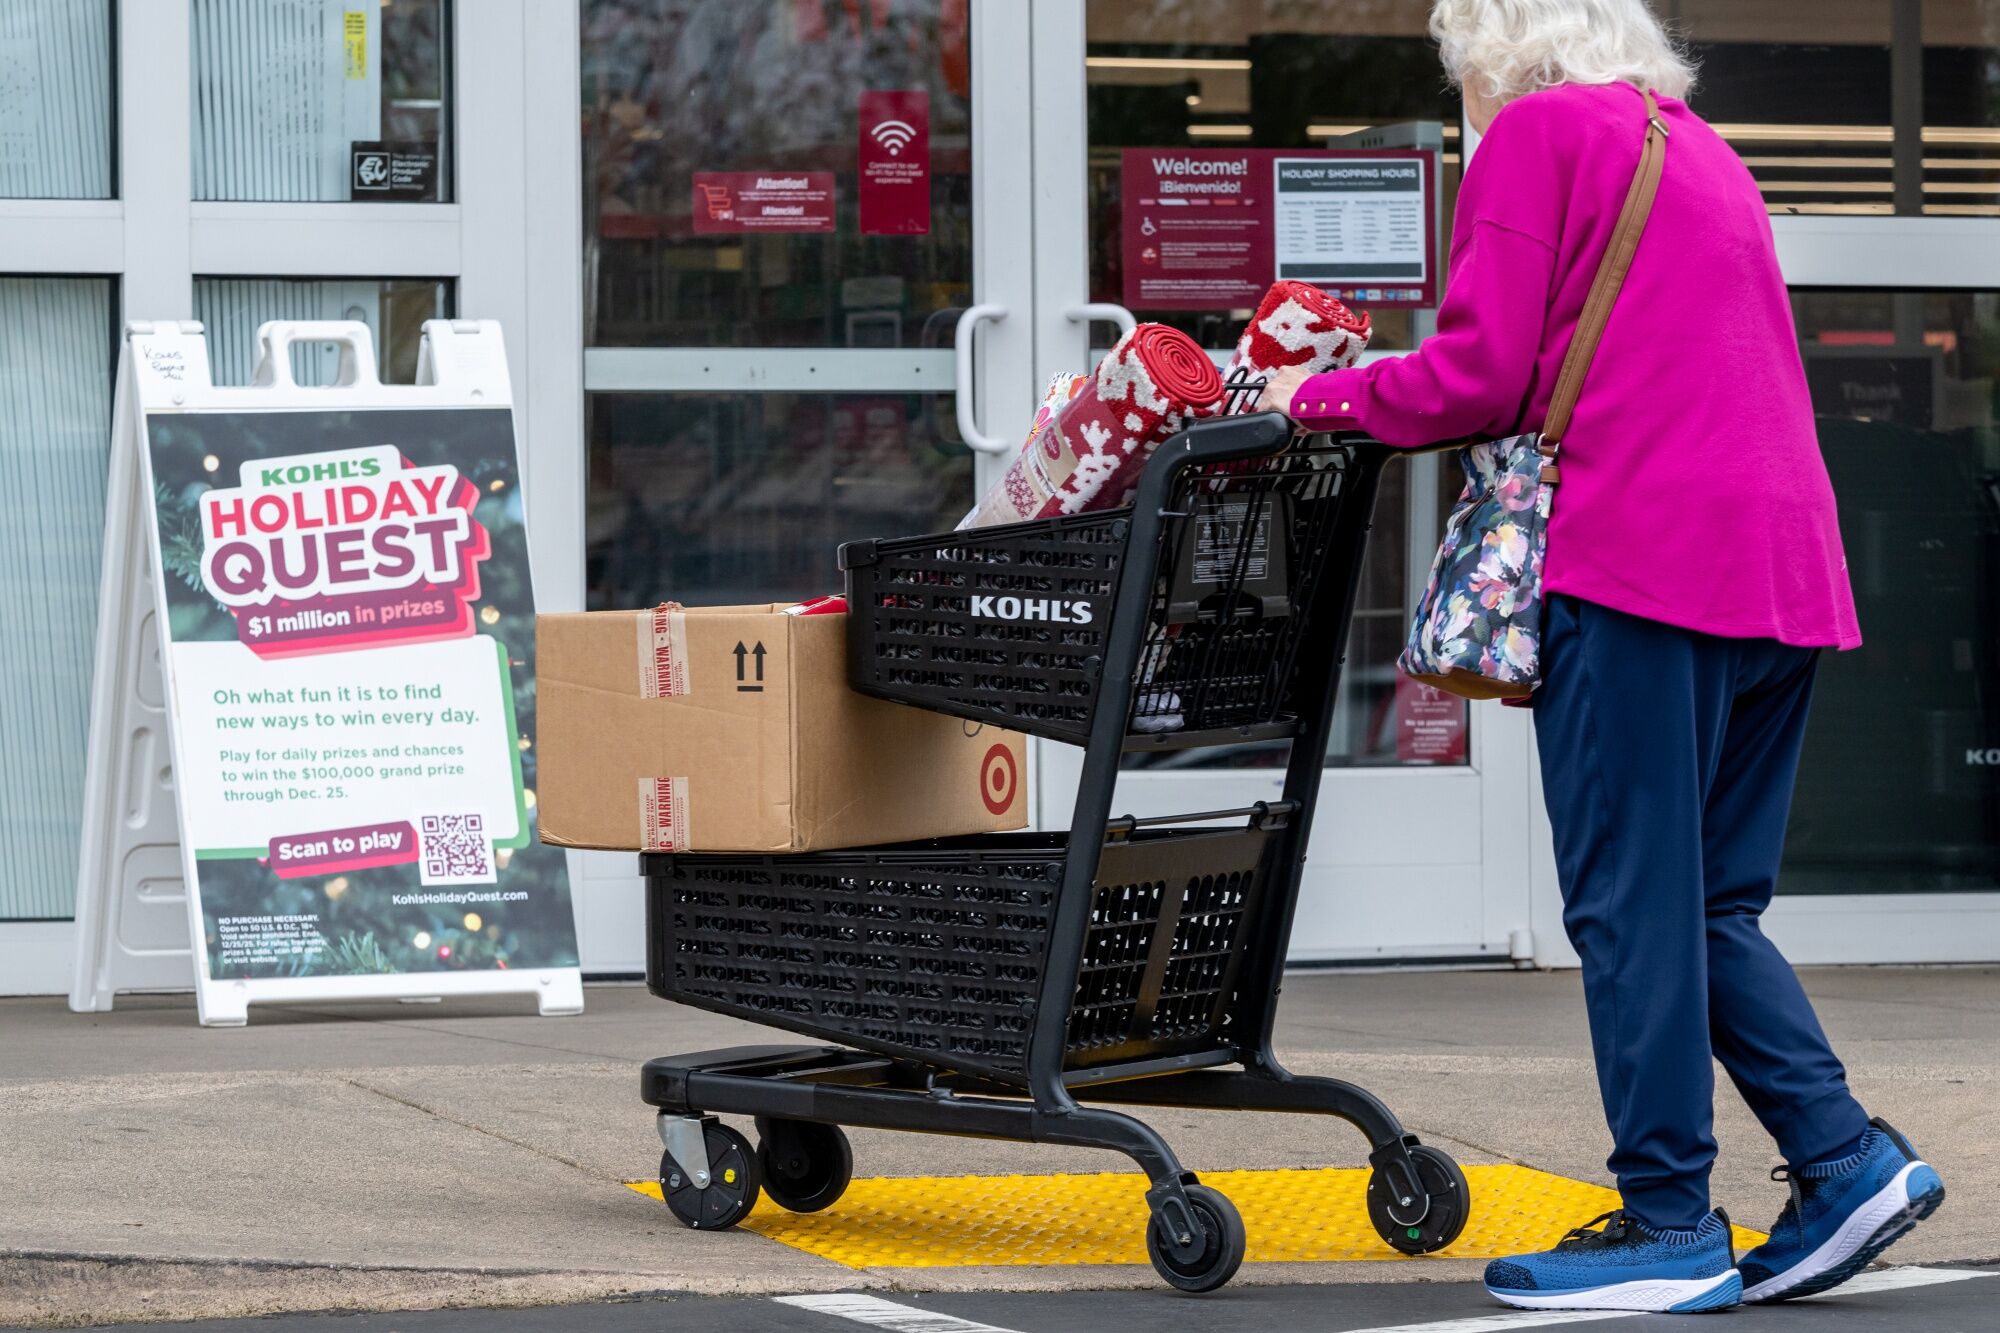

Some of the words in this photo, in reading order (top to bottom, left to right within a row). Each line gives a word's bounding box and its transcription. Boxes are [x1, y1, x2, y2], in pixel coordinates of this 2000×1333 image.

[392, 160, 430, 168] Electronic
[392, 168, 421, 176] Product
[1152, 158, 1248, 175] Welcome!
[1281, 169, 1326, 179] HOLIDAY
[1328, 168, 1379, 179] SHOPPING
[1381, 168, 1417, 178] HOURS
[756, 178, 808, 190] Attention!
[1160, 180, 1241, 193] ¡Bienvenido!
[261, 458, 381, 487] KOHL'S
[210, 475, 446, 539] HOLIDAY
[211, 518, 458, 596] QUEST
[248, 617, 272, 637] $1
[276, 609, 350, 633] million
[355, 605, 376, 623] in
[380, 600, 445, 624] prizes
[971, 595, 1093, 625] KOHL'S
[656, 646, 673, 698] WARNING
[213, 689, 241, 705] Oh
[247, 688, 294, 704] what
[300, 687, 332, 703] fun
[337, 687, 351, 702] it
[357, 686, 372, 701] is
[378, 686, 398, 701] to
[404, 684, 442, 699] find
[216, 715, 255, 729] new
[262, 714, 309, 731] ways
[315, 712, 335, 727] to
[342, 710, 375, 726] win
[381, 711, 434, 727] every
[440, 707, 479, 726] day.
[219, 750, 251, 764] Play
[255, 748, 277, 762] for
[282, 747, 318, 762] daily
[322, 746, 368, 762] prizes
[372, 745, 400, 759] and
[404, 744, 464, 757] chances
[222, 770, 237, 782] to
[242, 769, 268, 781] win
[273, 768, 297, 780] the
[302, 766, 375, 781] $100,000
[380, 765, 423, 780] grand
[427, 764, 465, 778] prize
[224, 788, 283, 802] through
[288, 788, 321, 800] Dec.
[326, 787, 349, 799] 25.
[657, 776, 672, 828] WARNING
[278, 840, 328, 861] Scan
[332, 837, 355, 854] to
[360, 831, 403, 853] play
[392, 891, 529, 905] KohlsHolidayQuest.com
[219, 917, 230, 925] NO
[232, 916, 272, 924] PURCHASE
[274, 914, 319, 923] NECESSARY.
[220, 932, 237, 940] Void
[239, 932, 260, 940] where
[262, 931, 300, 940] prohibited.
[302, 930, 320, 938] Ends
